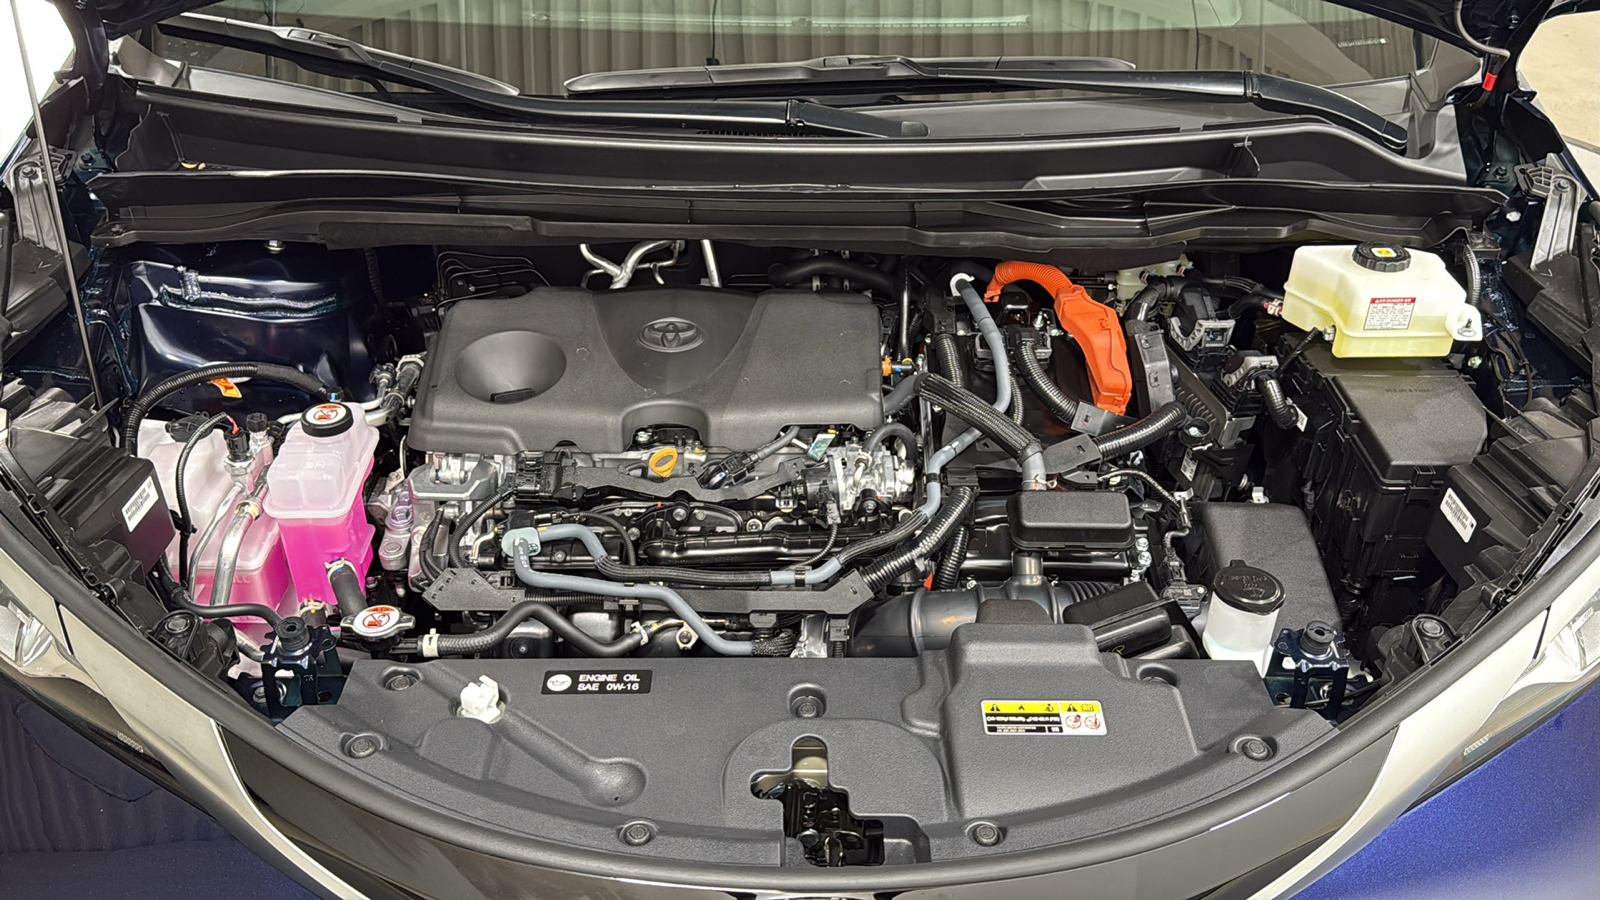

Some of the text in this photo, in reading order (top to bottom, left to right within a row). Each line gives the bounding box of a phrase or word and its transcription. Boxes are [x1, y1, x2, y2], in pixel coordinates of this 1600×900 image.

[578, 674, 640, 682] ENGINE OIL
[577, 683, 640, 691] SAE 0W-16
